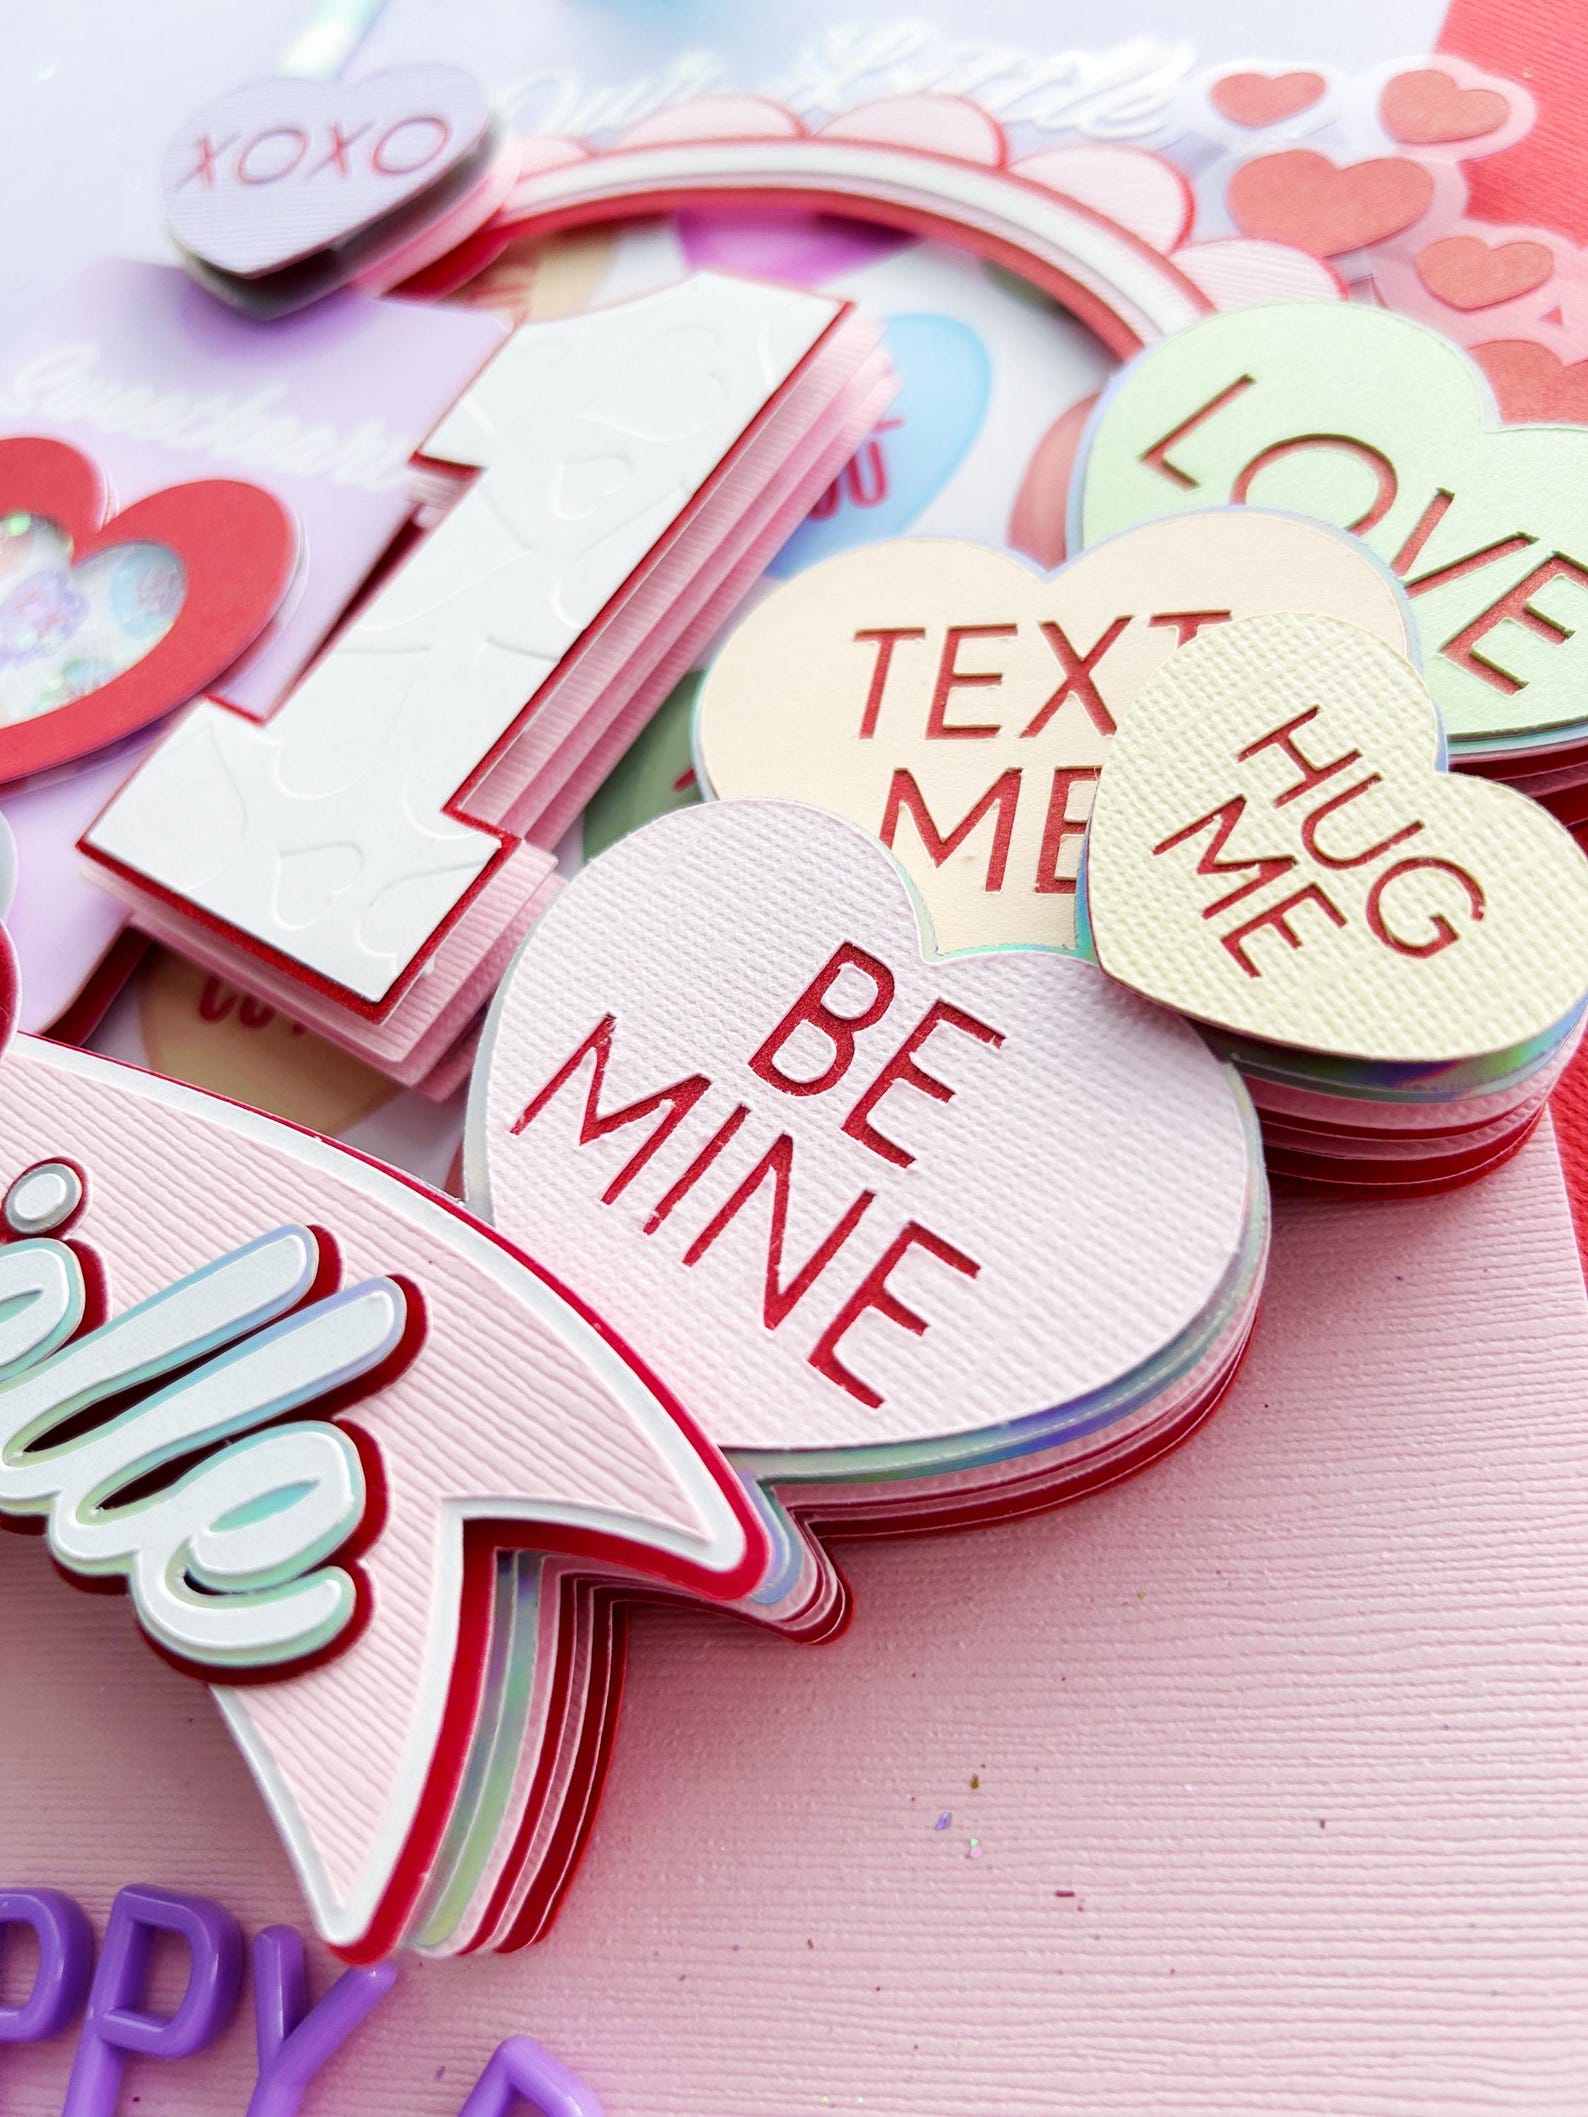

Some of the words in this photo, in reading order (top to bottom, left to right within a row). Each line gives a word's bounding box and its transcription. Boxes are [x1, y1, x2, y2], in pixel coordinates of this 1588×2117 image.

[175, 116, 451, 191] XOXO
[80, 270, 856, 1022] 1
[1139, 372, 1588, 697] LOVE
[877, 764, 1104, 894] ME
[1152, 794, 1346, 978] ME
[1237, 705, 1486, 959] HUG
[748, 941, 1006, 1168] BE
[509, 1013, 981, 1409] MINE
